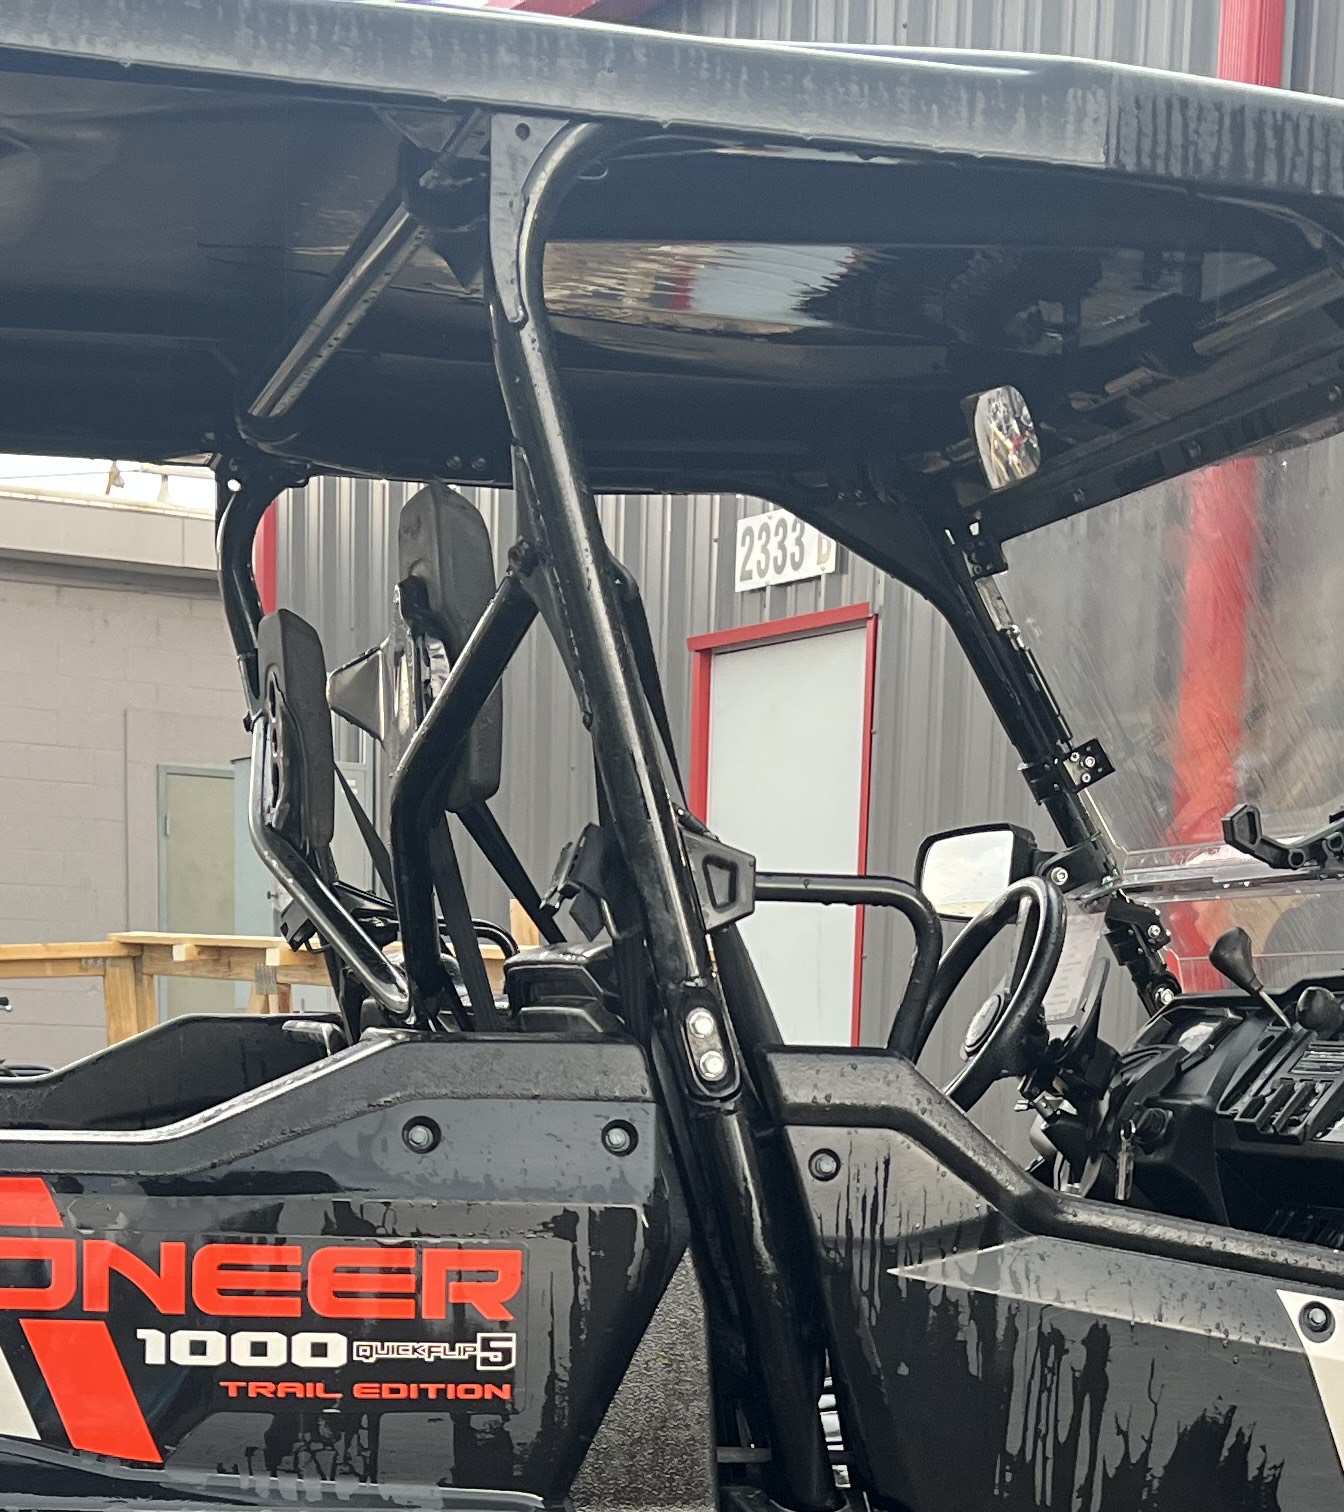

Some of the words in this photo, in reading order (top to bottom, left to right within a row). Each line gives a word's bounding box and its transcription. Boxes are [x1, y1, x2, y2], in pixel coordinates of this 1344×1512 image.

[740, 517, 805, 582] 2333
[136, 1328, 348, 1368] 1000
[219, 1380, 344, 1400] TRAIL
[353, 1382, 512, 1401] EDITION
